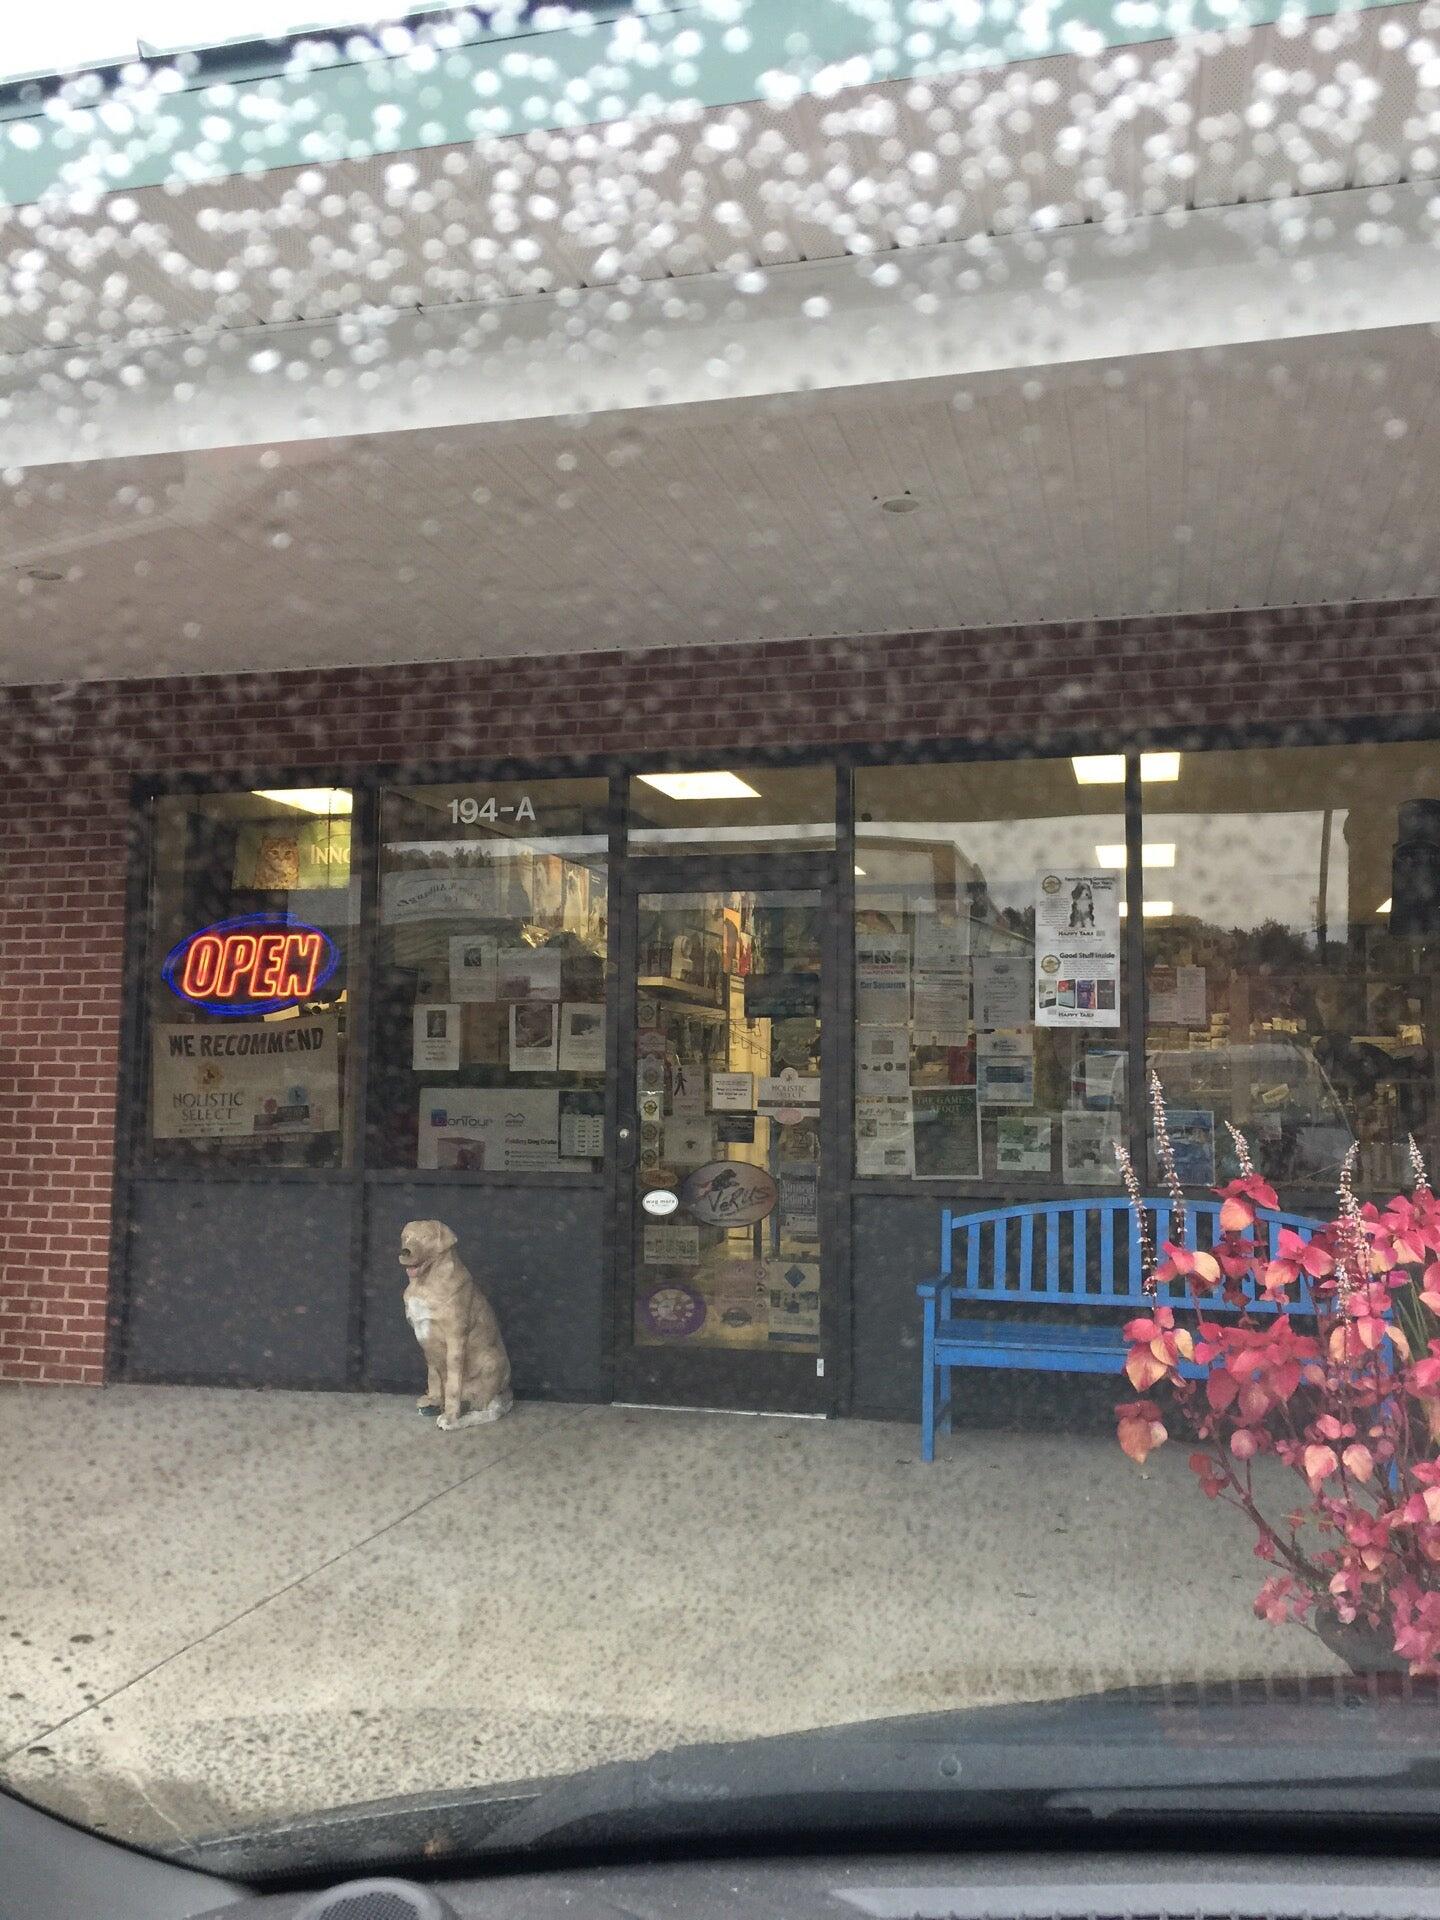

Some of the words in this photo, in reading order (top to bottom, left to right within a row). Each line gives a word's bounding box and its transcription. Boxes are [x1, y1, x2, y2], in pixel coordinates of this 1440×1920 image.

[448, 796, 536, 824] 194-A
[183, 935, 321, 998] OPEN
[168, 1035, 196, 1057] WE
[201, 1027, 324, 1057] RECOMMEND
[172, 1091, 244, 1109] HOLISTIC
[771, 1084, 807, 1097] HOLISTIC
[181, 1107, 235, 1122] SELECT
